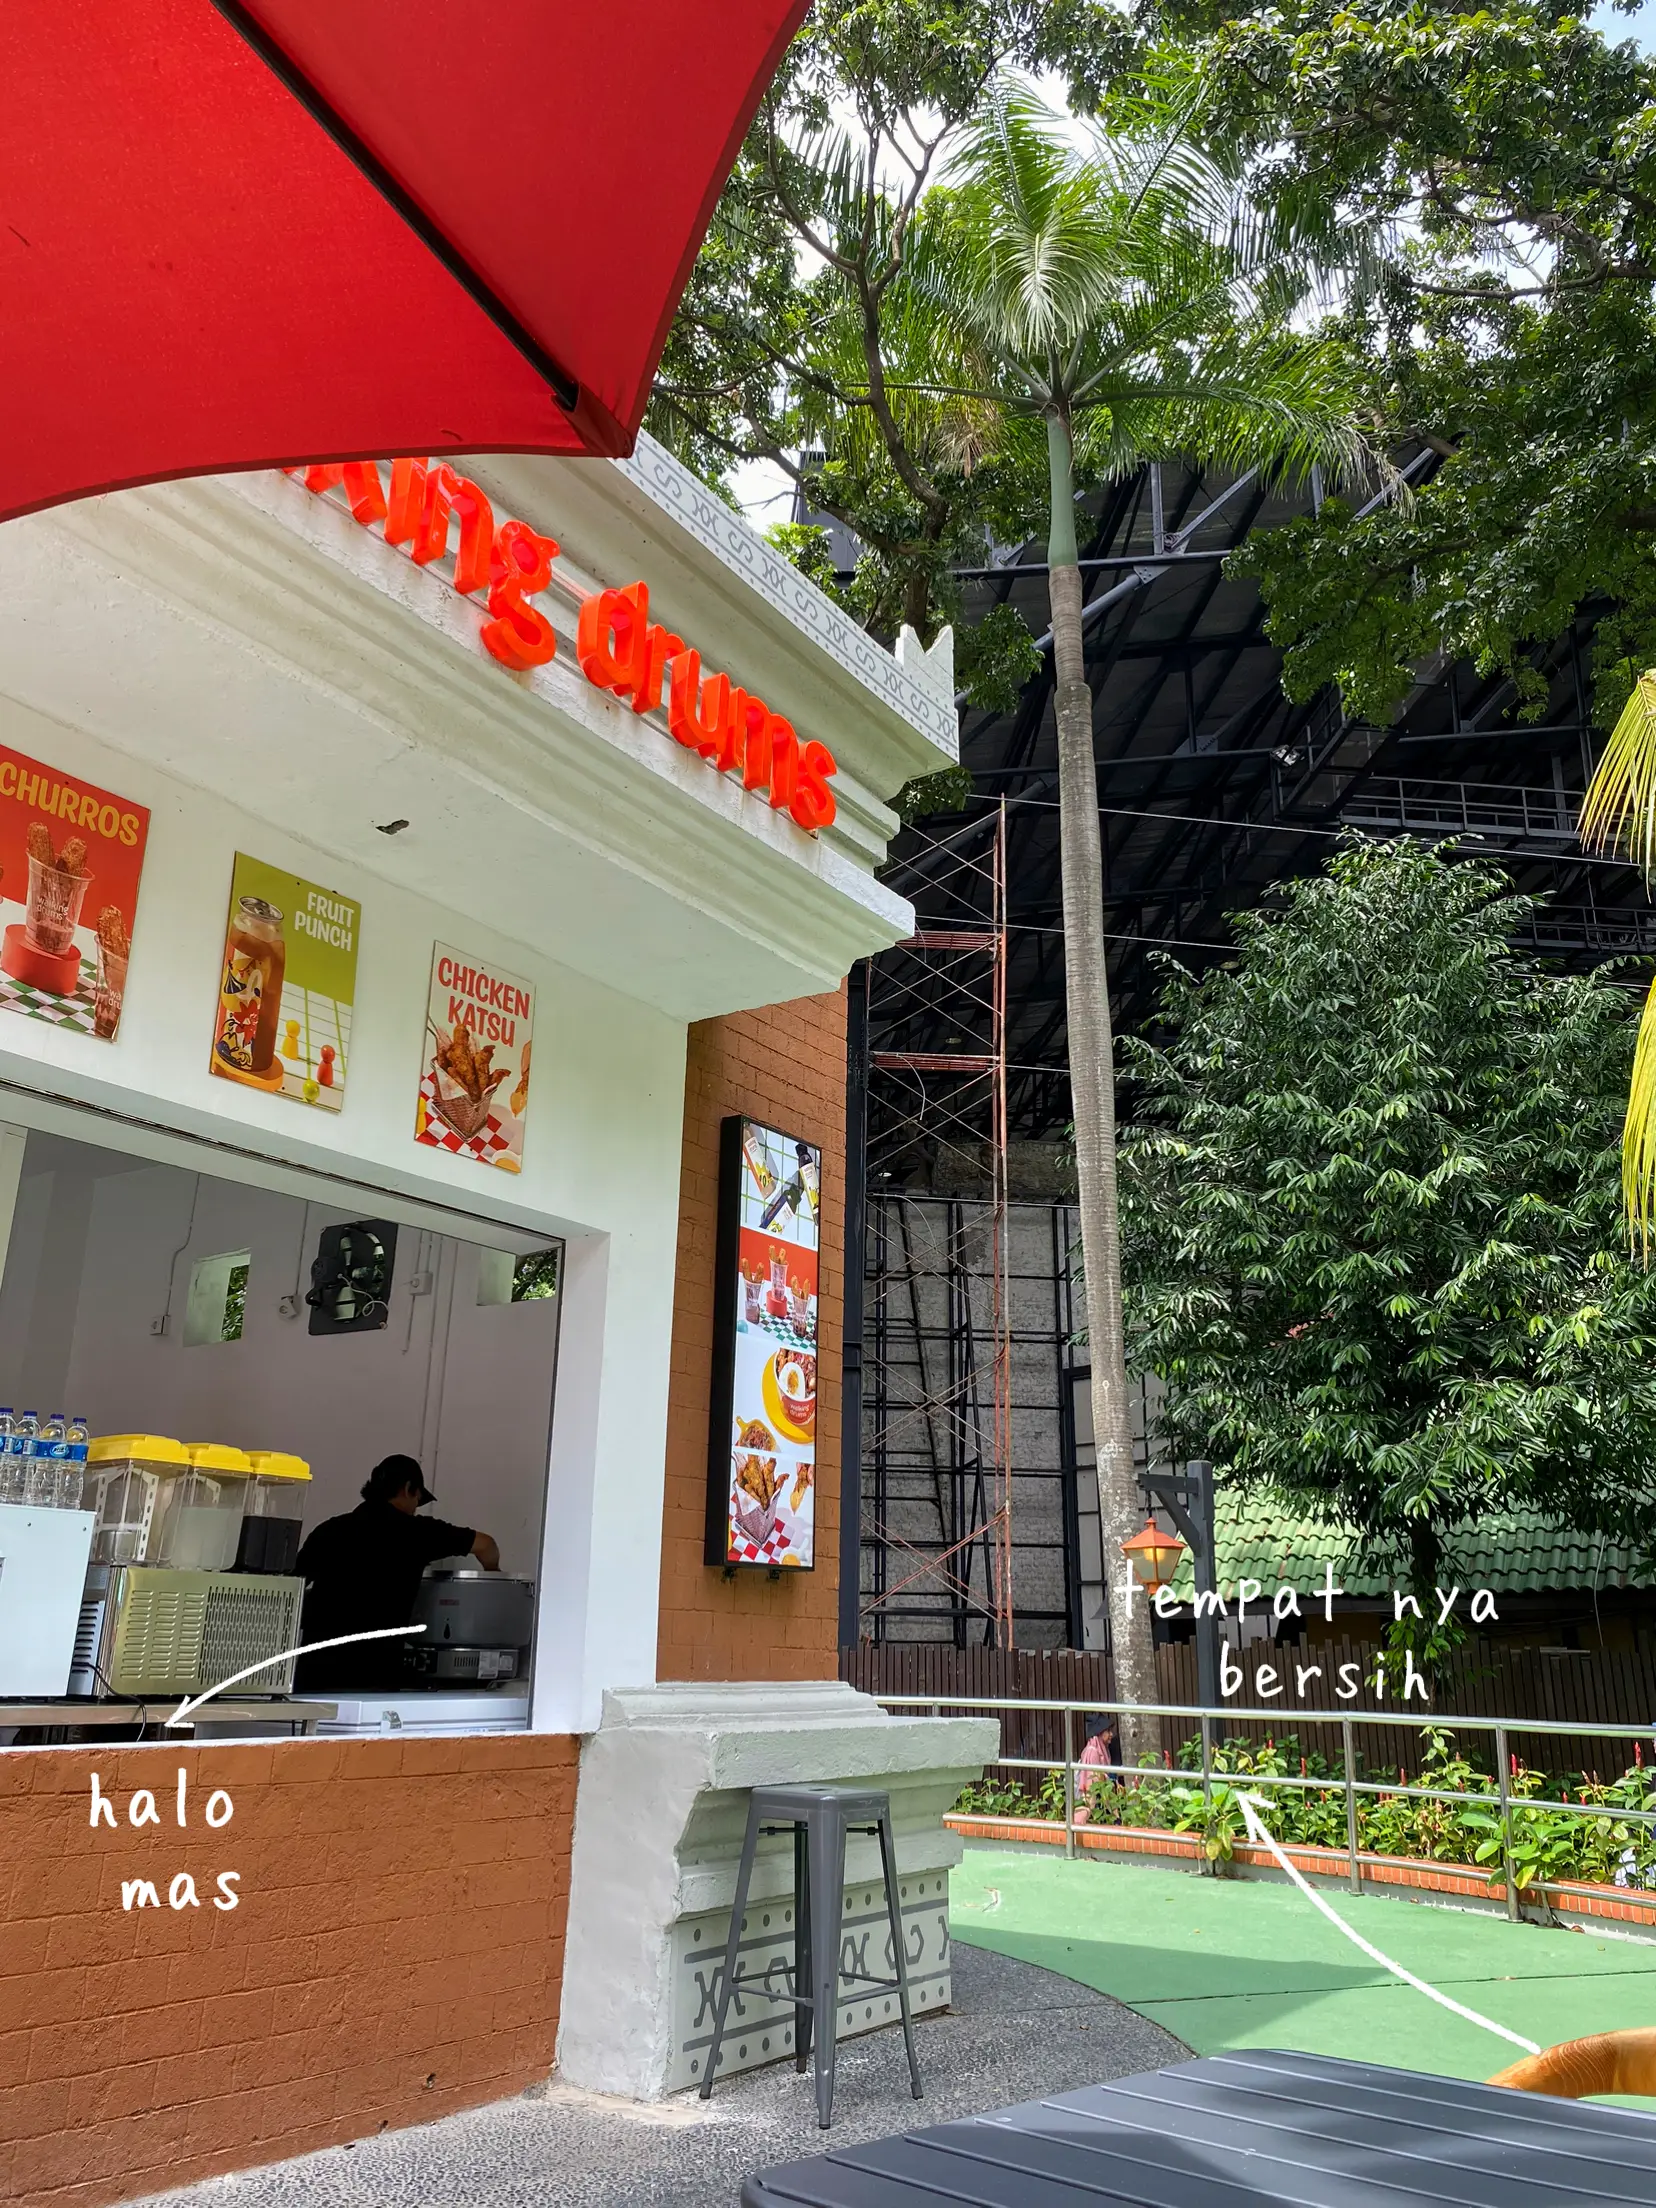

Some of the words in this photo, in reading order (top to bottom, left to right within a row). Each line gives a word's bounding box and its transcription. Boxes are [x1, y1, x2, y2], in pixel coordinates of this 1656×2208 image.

[577, 581, 838, 830] drums
[0, 762, 139, 846] CHURROS
[294, 911, 352, 952] PUNCH
[307, 891, 355, 928] FRUIT
[438, 957, 530, 1020] CHICKEN
[448, 995, 515, 1048] KATSU
